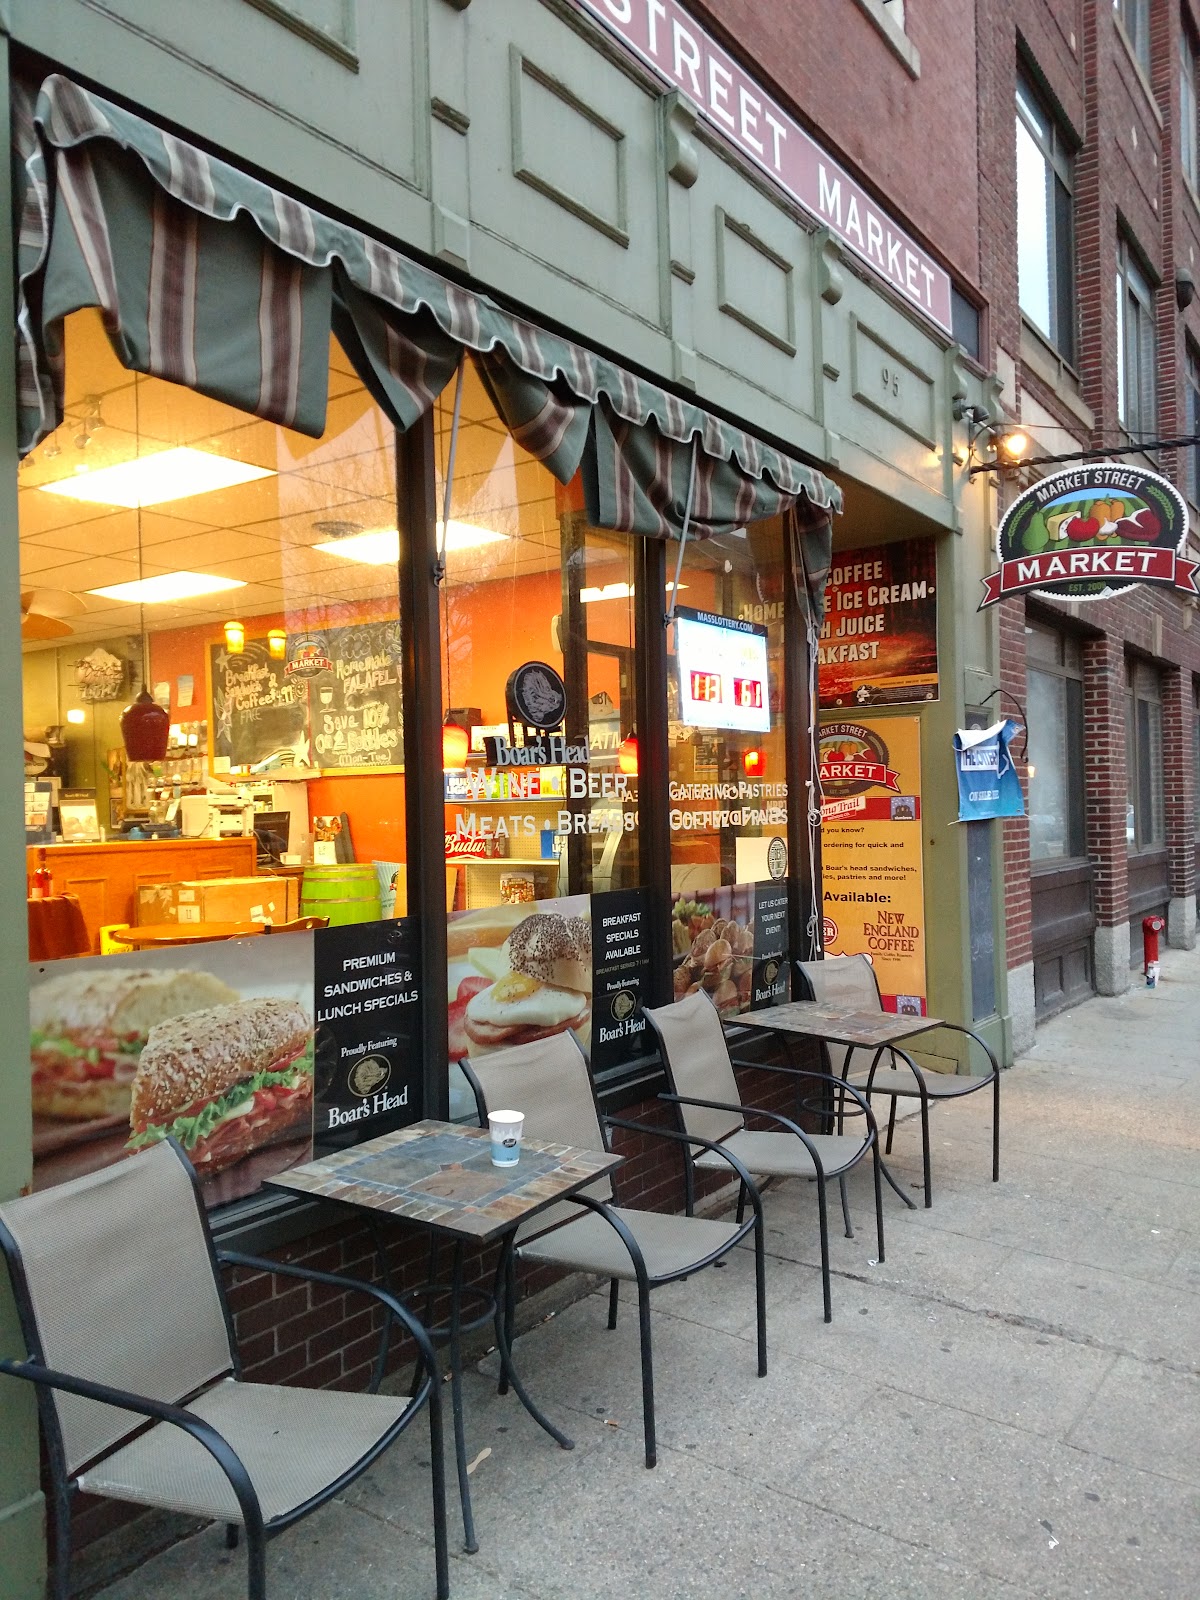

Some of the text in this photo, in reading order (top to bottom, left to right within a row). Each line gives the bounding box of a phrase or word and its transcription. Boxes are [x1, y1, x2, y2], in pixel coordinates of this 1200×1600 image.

[819, 164, 935, 308] MARKET
[881, 368, 899, 397] 95
[1036, 470, 1145, 503] MARKET STREET
[1017, 551, 1157, 582] MARKET
[837, 591, 863, 611] ICE
[867, 580, 927, 607] CREAM
[1068, 583, 1085, 592] EST.
[697, 612, 753, 633] MASSLOTTERY.COM
[836, 613, 885, 637] JUICE
[292, 659, 324, 670] MARKET
[740, 679, 761, 707] 61
[323, 715, 359, 734] Save
[840, 724, 868, 738] STREET
[493, 735, 591, 766] Boar's Head
[466, 767, 541, 800] WINE
[569, 768, 628, 799] BEER
[738, 781, 788, 798] PASTRIES
[838, 798, 860, 812] Trail
[455, 813, 535, 840] MEATS
[759, 897, 788, 909] LET US CATER
[823, 891, 891, 903] Available:
[602, 912, 641, 927] BREAKFAST
[761, 910, 785, 922] YOUR NEXT
[877, 911, 905, 925] NEW
[606, 928, 639, 943] SPECIALS
[863, 923, 919, 938] ENGLAND
[605, 945, 641, 960] AVAILABLE
[868, 937, 915, 951] COFFEE
[342, 951, 396, 971] PREMIUM
[595, 965, 620, 976] BREAKFAST
[324, 970, 413, 998] SANDWICHES &
[606, 981, 622, 991] Proudly
[755, 981, 786, 1001] Boar's Head
[317, 990, 419, 1022] LUNCH SPECIALS
[599, 1018, 646, 1043] Boar's Head
[341, 1036, 398, 1058] Proudly Featuring
[328, 1084, 408, 1128] Boar's Head
